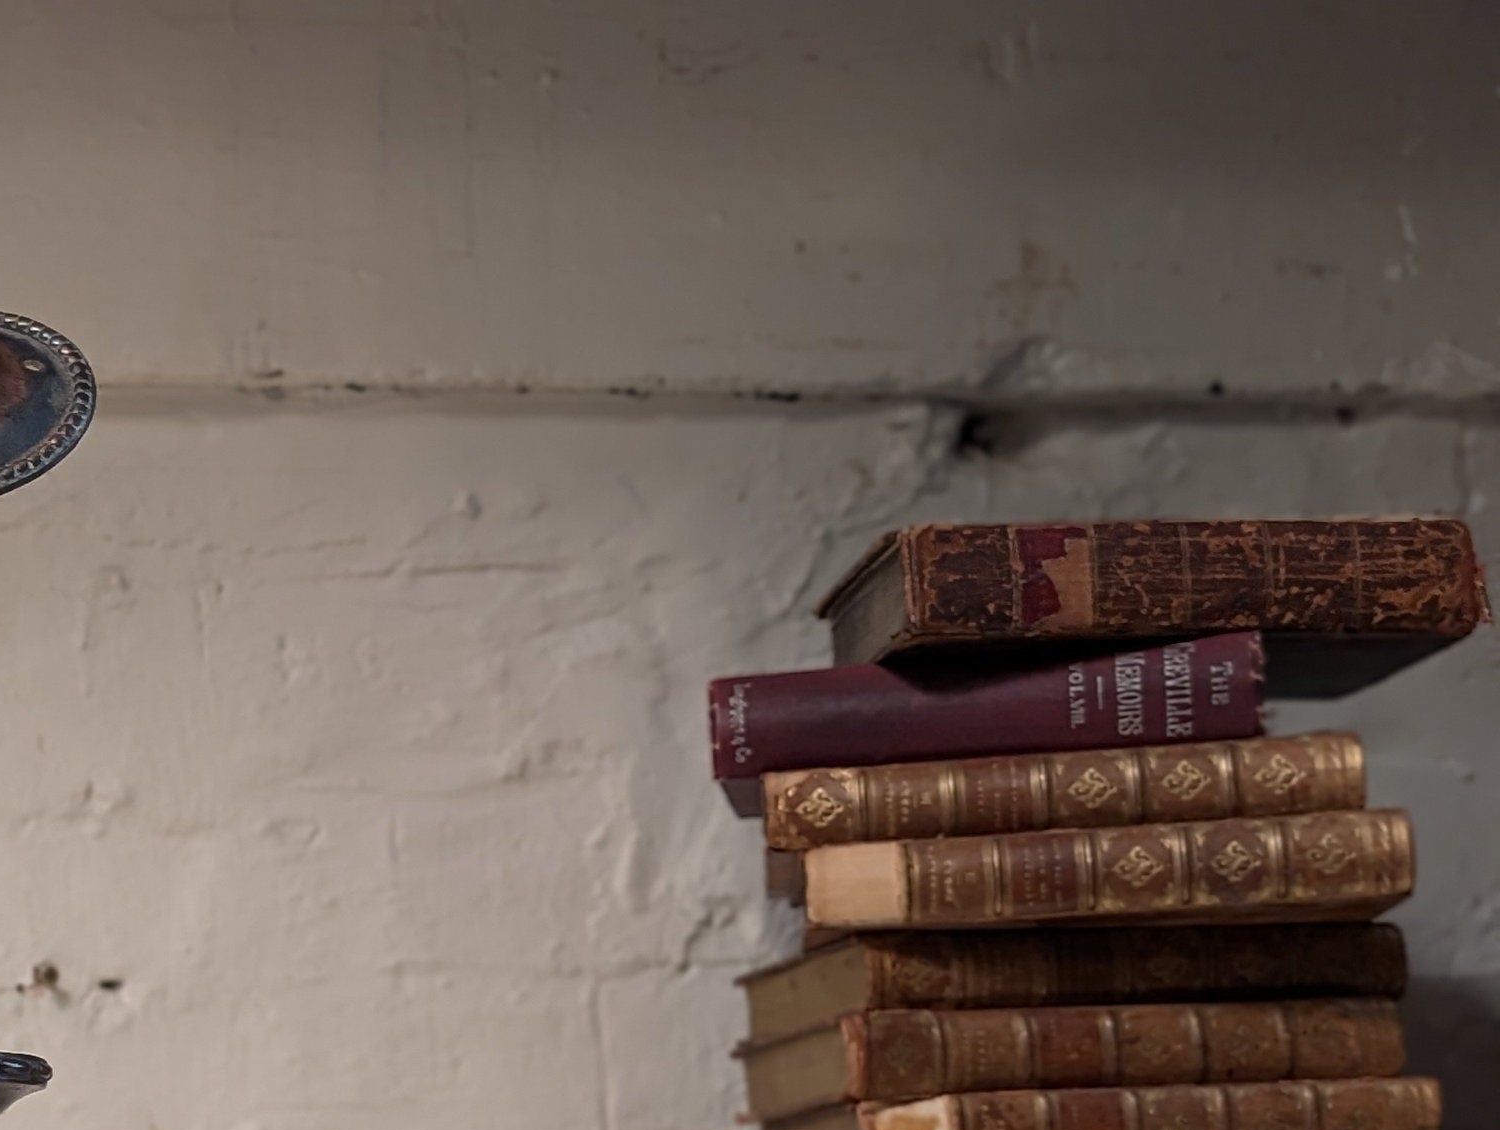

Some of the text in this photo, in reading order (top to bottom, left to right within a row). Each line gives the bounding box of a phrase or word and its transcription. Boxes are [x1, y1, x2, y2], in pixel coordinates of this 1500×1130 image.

[1114, 652, 1145, 736] MEMOIRS
[1163, 642, 1195, 737] GREVILLE
[1210, 661, 1234, 706] THE
